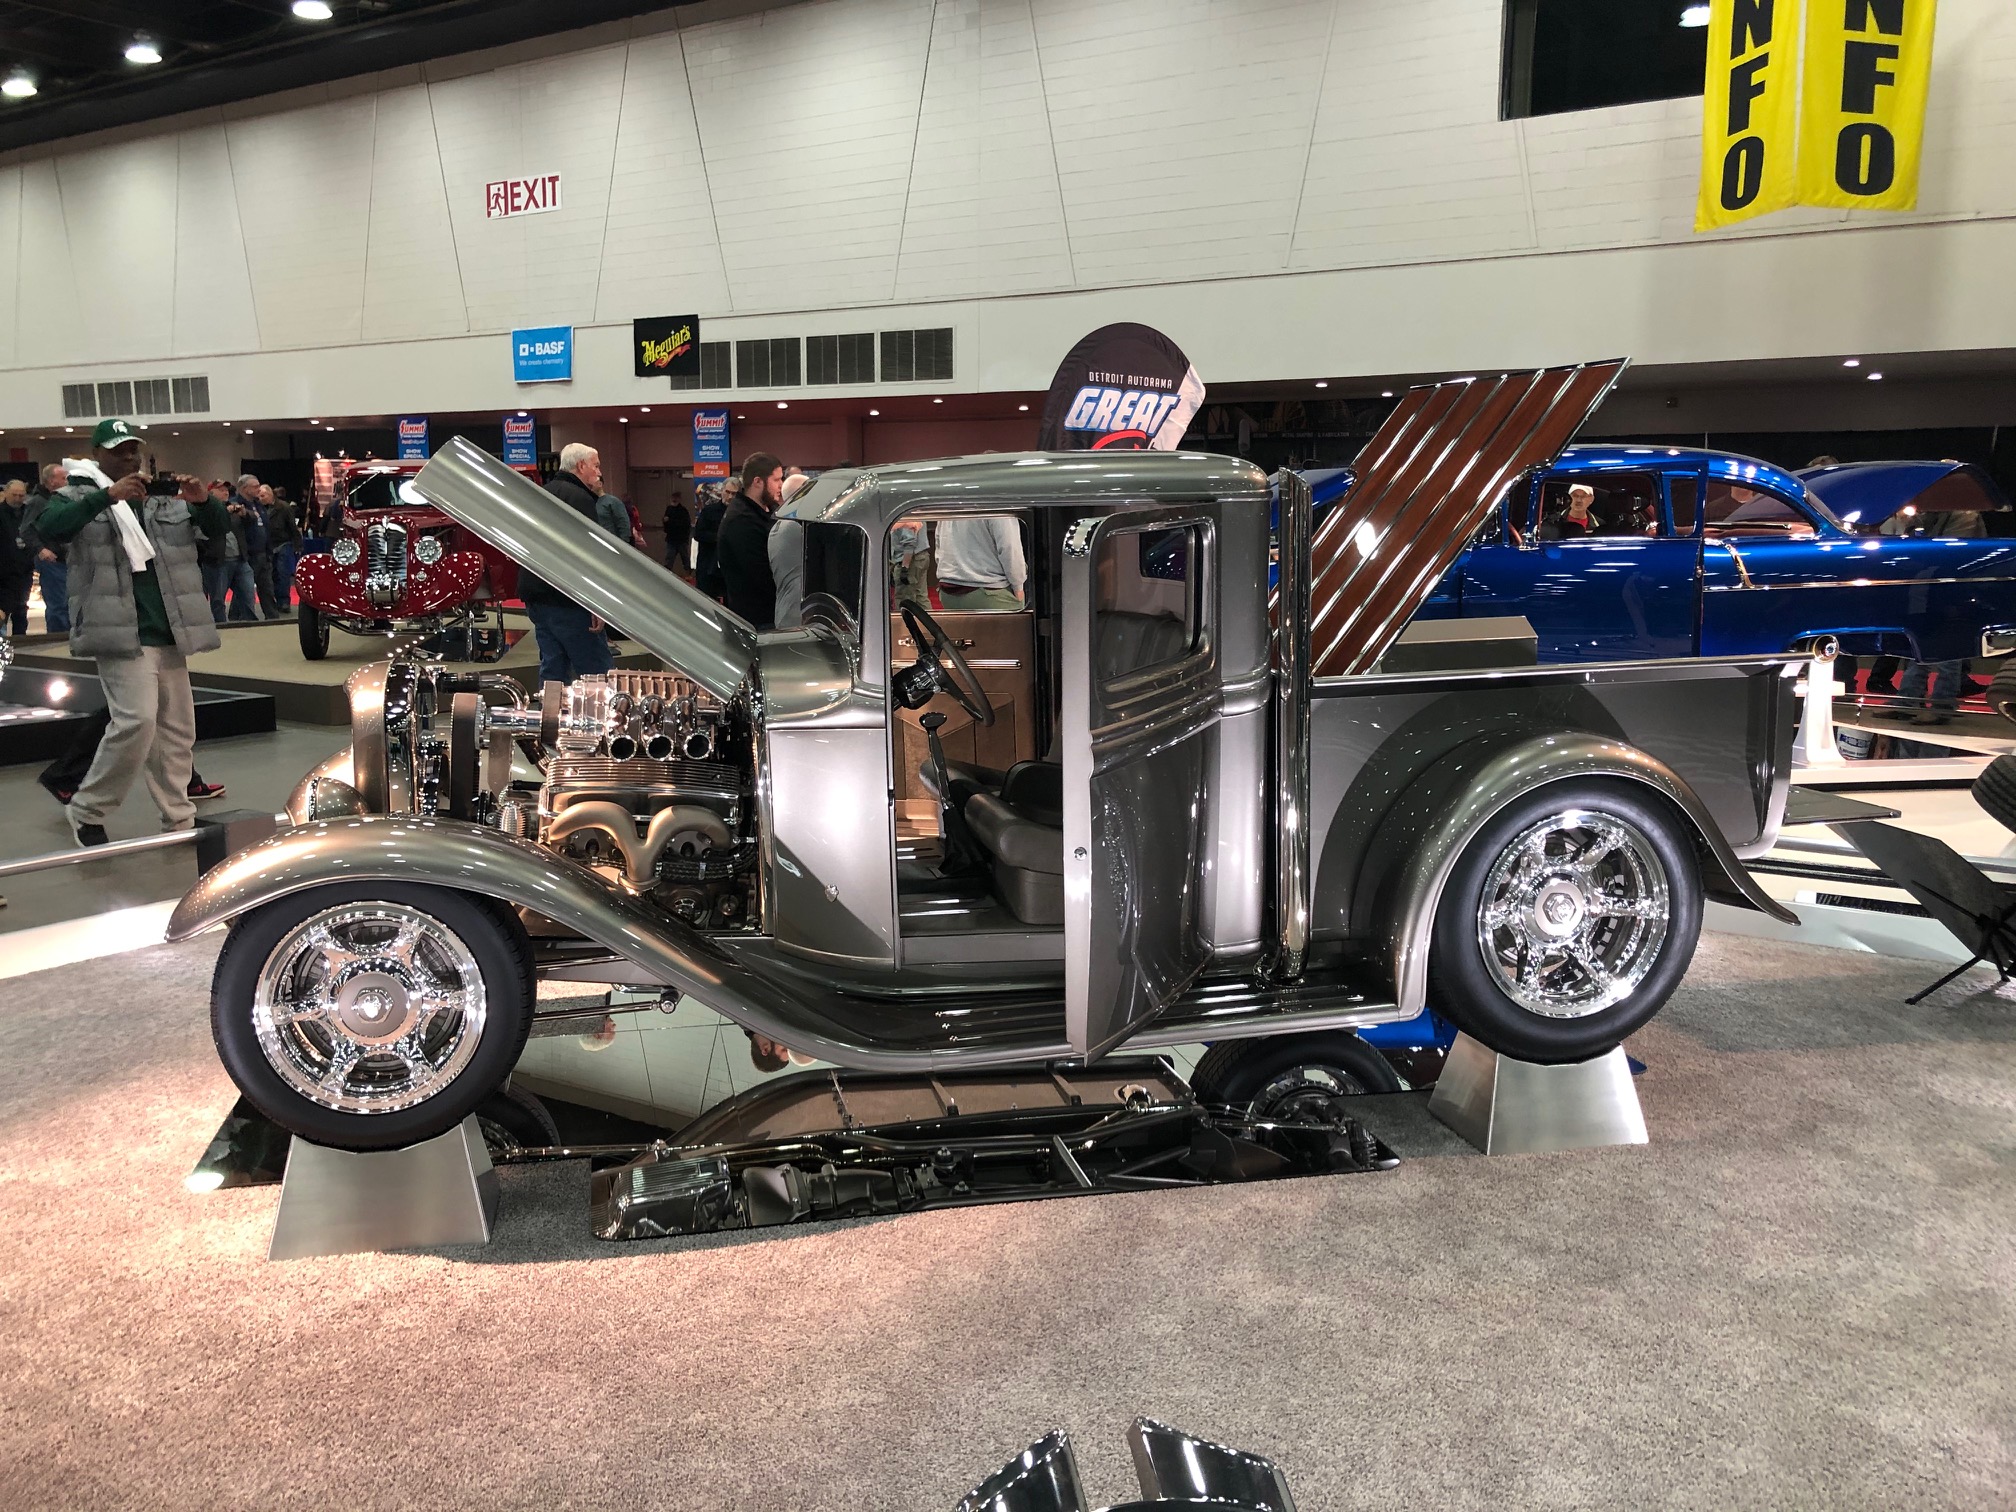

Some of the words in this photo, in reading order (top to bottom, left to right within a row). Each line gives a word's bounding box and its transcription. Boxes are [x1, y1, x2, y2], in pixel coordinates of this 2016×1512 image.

[510, 175, 560, 212] EXIT
[535, 341, 565, 356] BASF
[641, 325, 691, 367] Meguiar's
[1089, 371, 1124, 384] DETROIT
[1127, 374, 1173, 389] AUTORAMA
[1064, 386, 1181, 436] GREAT
[400, 421, 425, 434] SUMMIT
[505, 420, 532, 433] SUMMIT
[696, 415, 725, 428] SUMMIT
